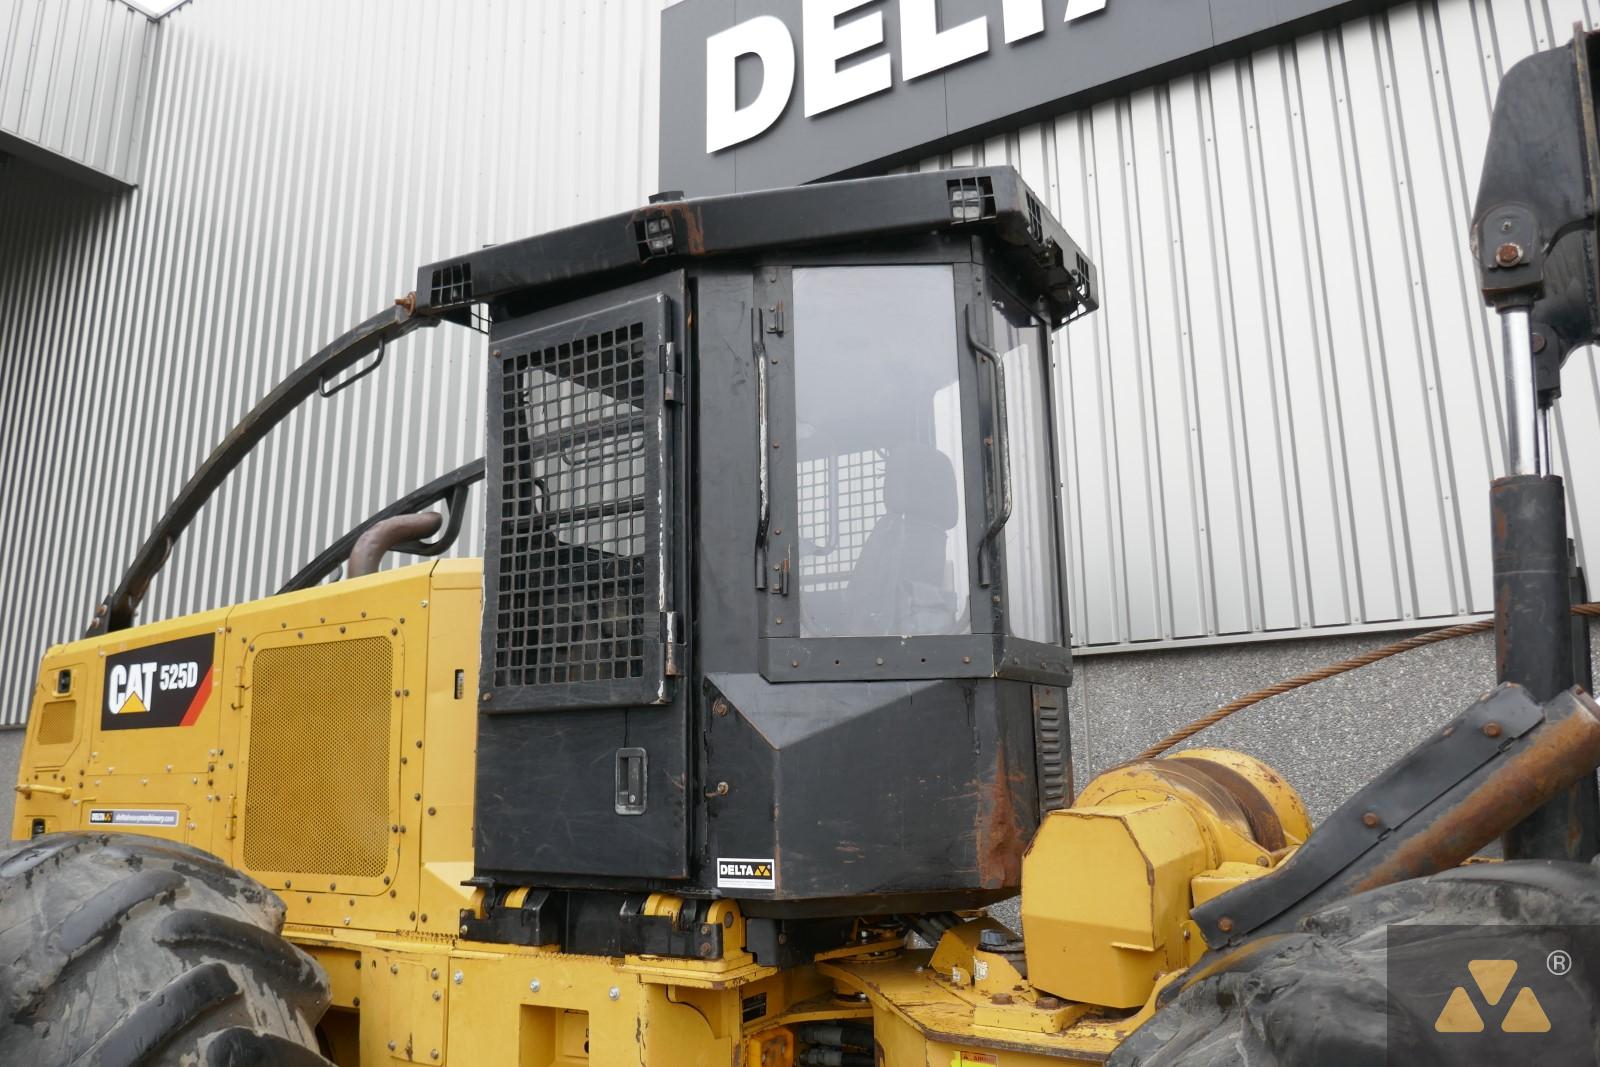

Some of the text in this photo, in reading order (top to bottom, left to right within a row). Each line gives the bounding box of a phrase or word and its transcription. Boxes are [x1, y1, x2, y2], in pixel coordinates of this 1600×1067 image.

[706, 0, 1108, 153] DEL
[109, 662, 199, 714] CAT 525D
[720, 864, 754, 876] DELTA
